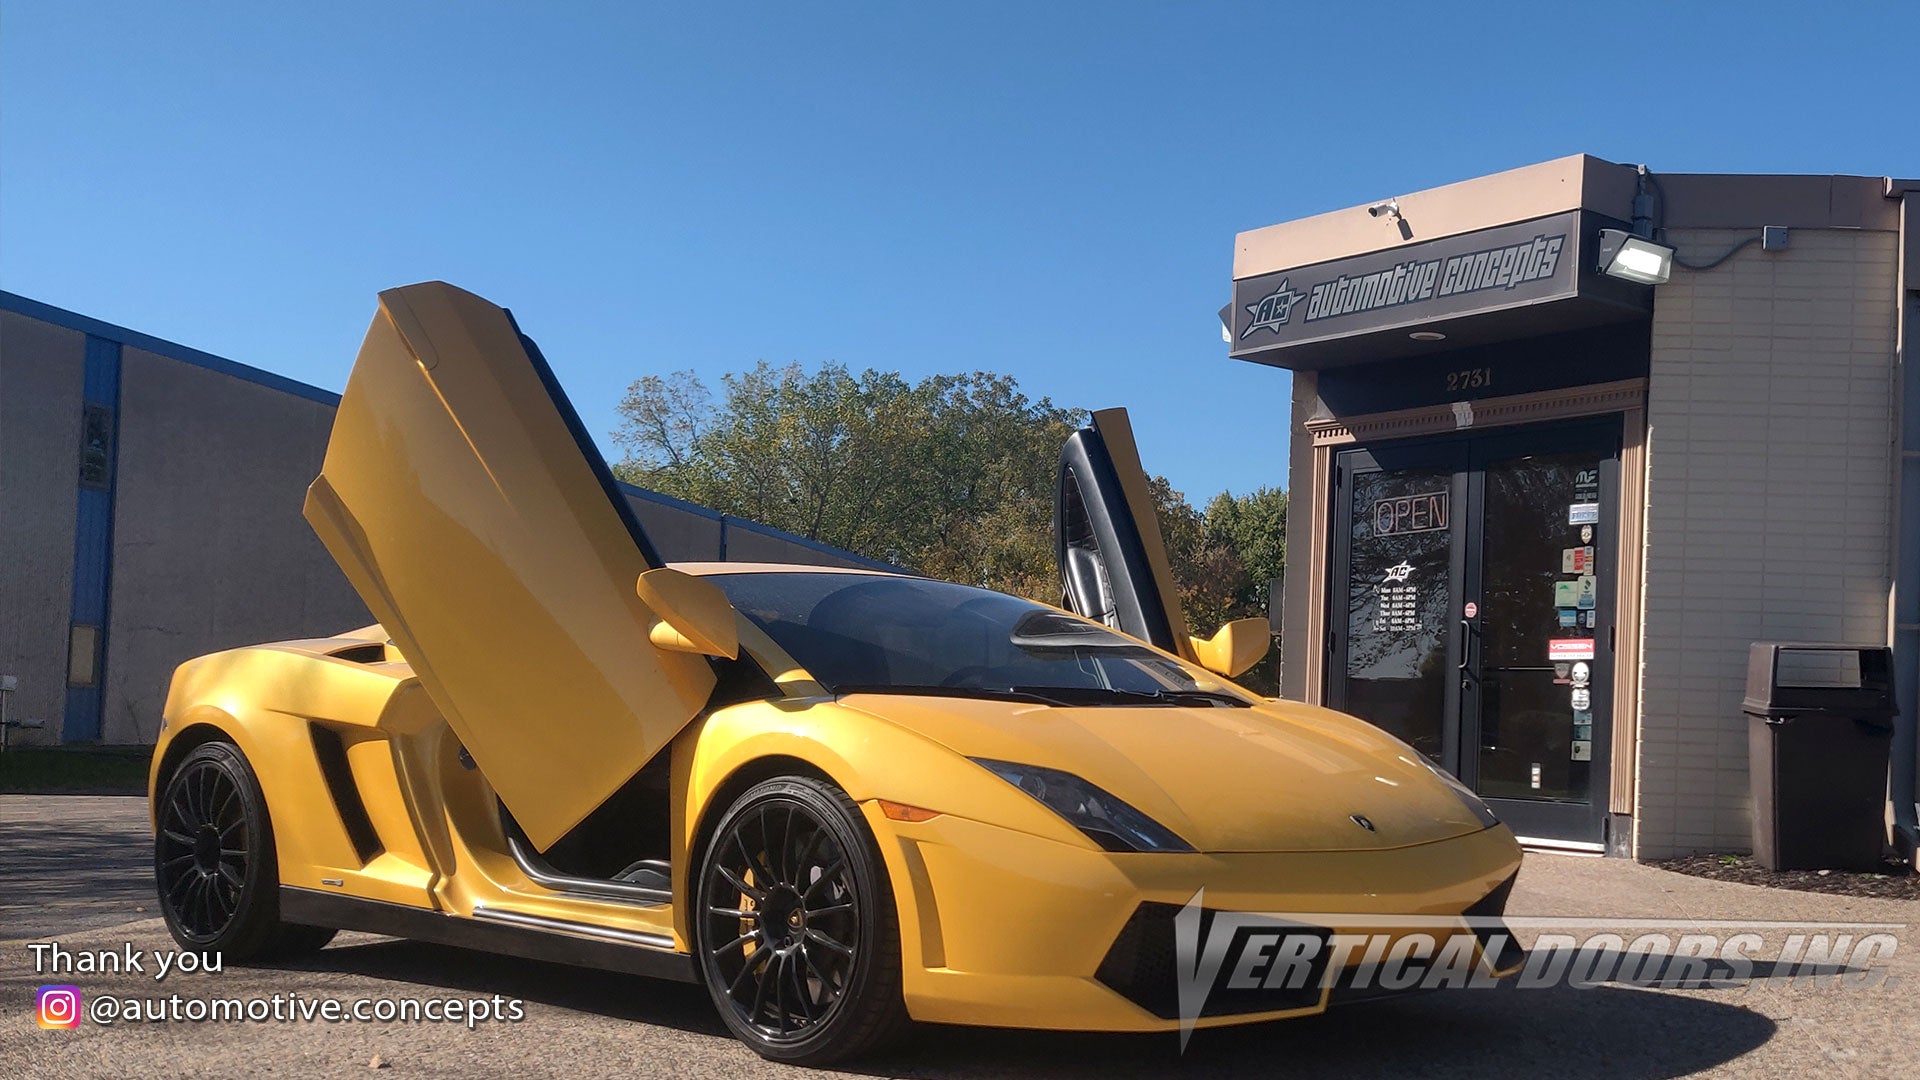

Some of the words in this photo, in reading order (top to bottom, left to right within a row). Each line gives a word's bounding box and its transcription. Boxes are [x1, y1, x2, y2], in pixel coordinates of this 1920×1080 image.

[1305, 260, 1441, 322] automotive
[1439, 235, 1565, 298] concepts
[1446, 367, 1491, 391] 2731
[1378, 494, 1446, 533] OPEN
